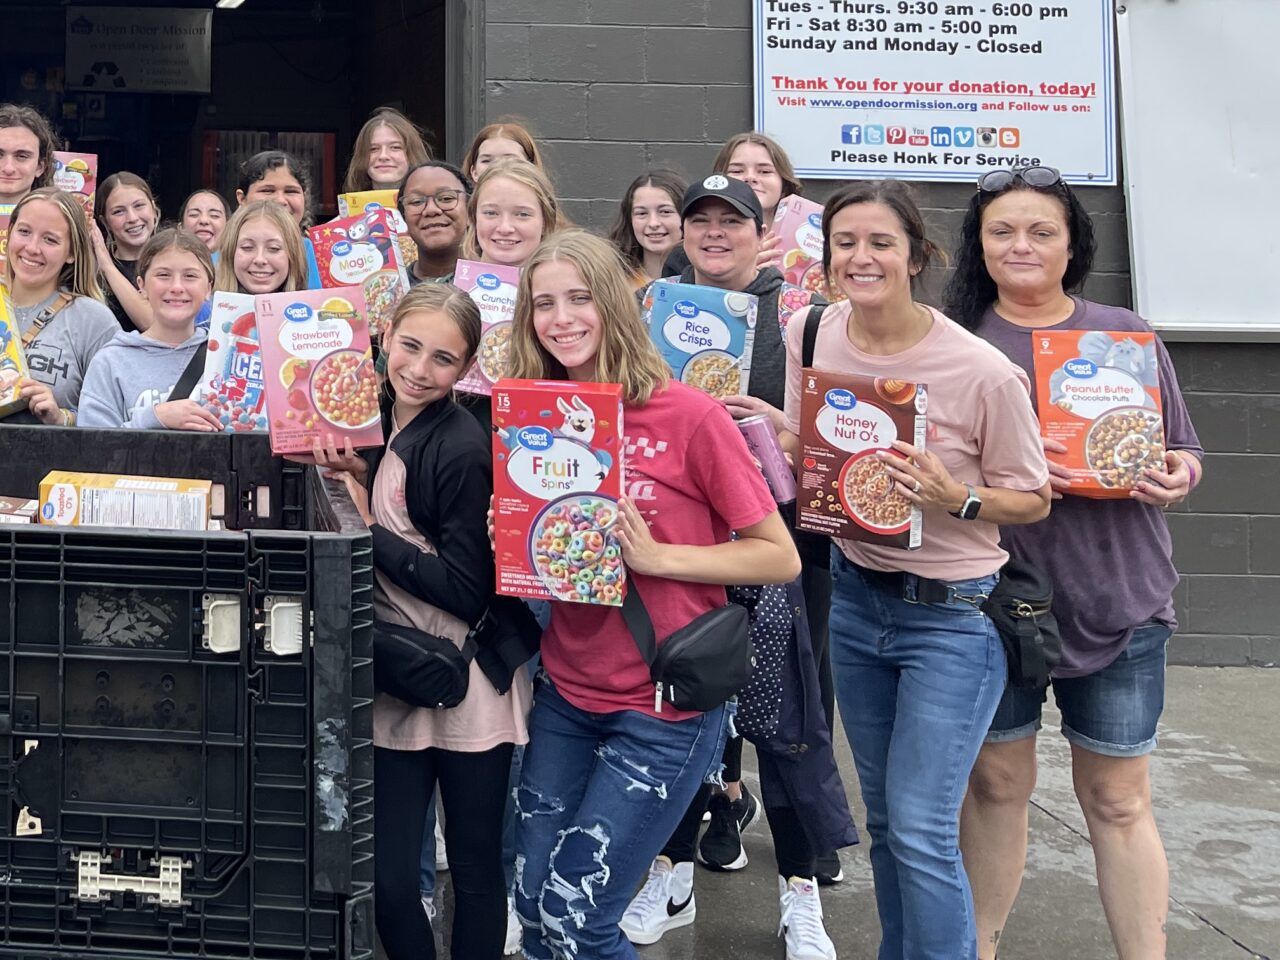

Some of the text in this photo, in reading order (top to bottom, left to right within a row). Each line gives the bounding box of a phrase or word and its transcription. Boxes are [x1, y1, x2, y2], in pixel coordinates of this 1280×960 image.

[766, 0, 812, 13] Tues
[829, 0, 891, 14] Thurs.
[897, 1, 938, 15] 9:30
[944, 5, 974, 16] am
[991, 3, 1033, 17] 6:00
[1039, 6, 1068, 21] pm
[766, 17, 791, 31] Fri
[808, 18, 841, 32] Sat
[846, 19, 887, 33] 8:30
[893, 22, 923, 33] am
[941, 20, 982, 35] 5:00
[988, 24, 1018, 38] pm
[766, 35, 837, 53] Sunday
[842, 37, 878, 51] and
[884, 37, 959, 56] Monday
[976, 39, 1043, 54] Closed
[771, 76, 1097, 99] Thank You for your donation, today!
[777, 96, 1091, 113] Visit www.opendoormission.org and Follow us on:
[831, 150, 1041, 167] Please Honk For Service
[338, 254, 375, 271] Magic
[462, 267, 469, 276] 9
[261, 303, 272, 312] 11
[286, 307, 308, 315] Great
[685, 321, 710, 335] Rice
[291, 330, 341, 341] Strawberry
[678, 332, 713, 348] Crisps
[292, 340, 343, 351] Lemonade
[1041, 340, 1050, 350] 9
[1066, 362, 1092, 371] Great
[808, 379, 816, 389] 8
[1065, 384, 1134, 394] Peanut Butter
[497, 396, 511, 407] 15
[828, 392, 851, 402] Great
[1071, 394, 1111, 402] Chocolate
[836, 414, 878, 432] Honey
[520, 431, 548, 441] Great
[834, 427, 879, 443] Nut O's
[527, 439, 548, 447] Value
[532, 456, 580, 478] Fruit
[57, 487, 65, 518] Toasted
[65, 496, 73, 510] O's
